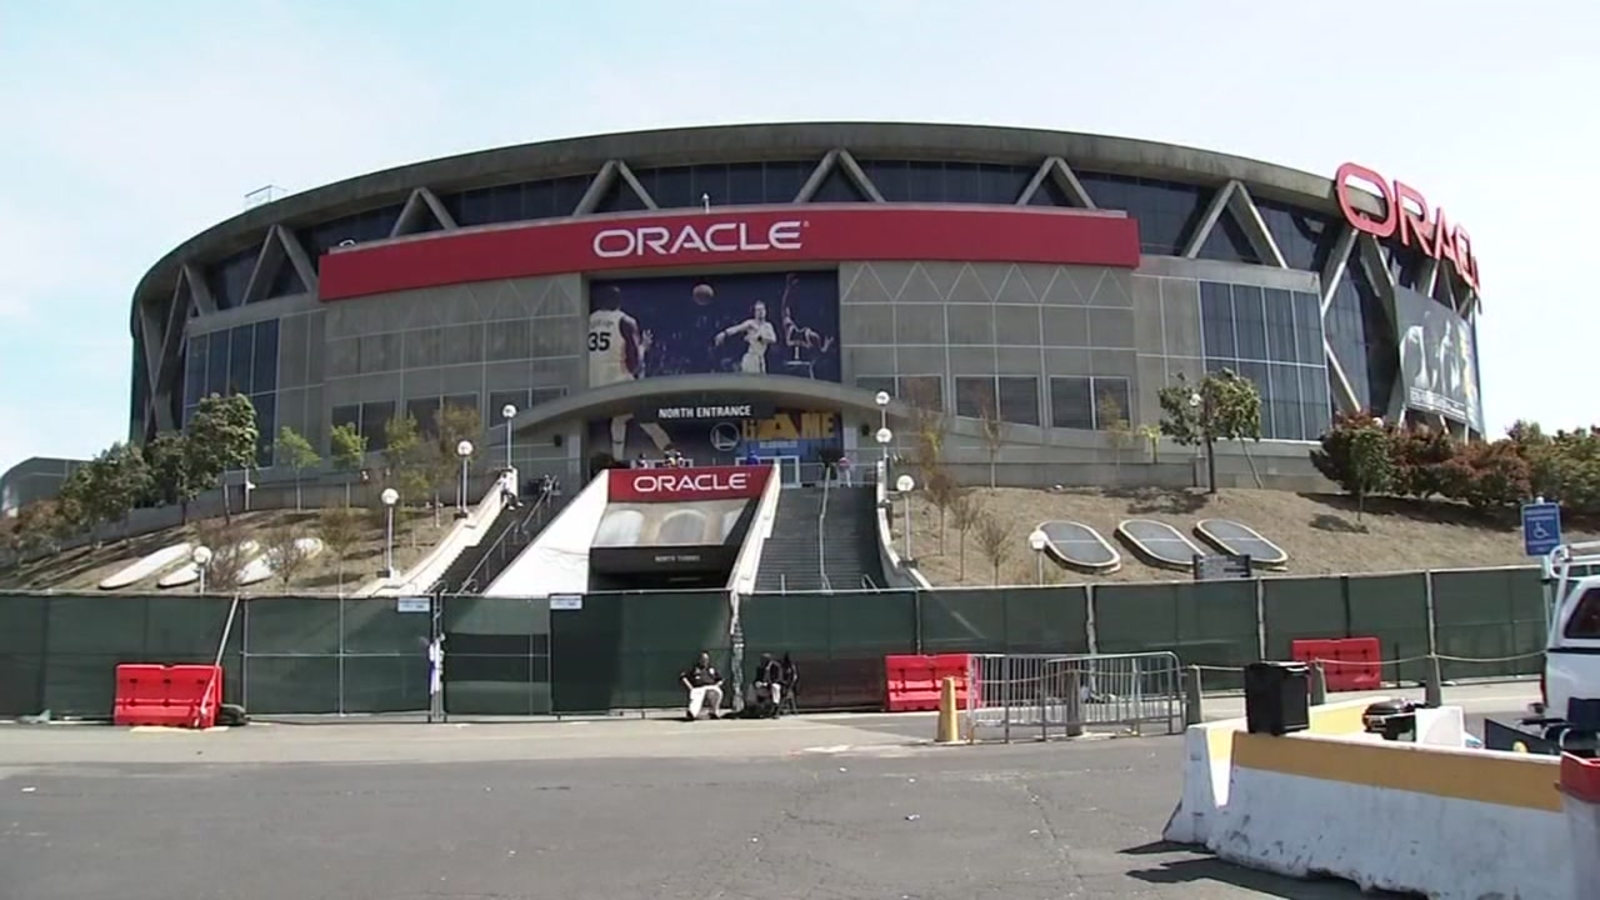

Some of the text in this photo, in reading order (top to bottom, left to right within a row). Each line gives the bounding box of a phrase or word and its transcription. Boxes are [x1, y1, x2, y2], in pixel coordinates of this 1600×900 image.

[593, 220, 803, 258] ORACLE
[588, 331, 611, 352] 35
[658, 405, 752, 419] NORTH ENTRANCE
[634, 472, 748, 493] ORACLE
